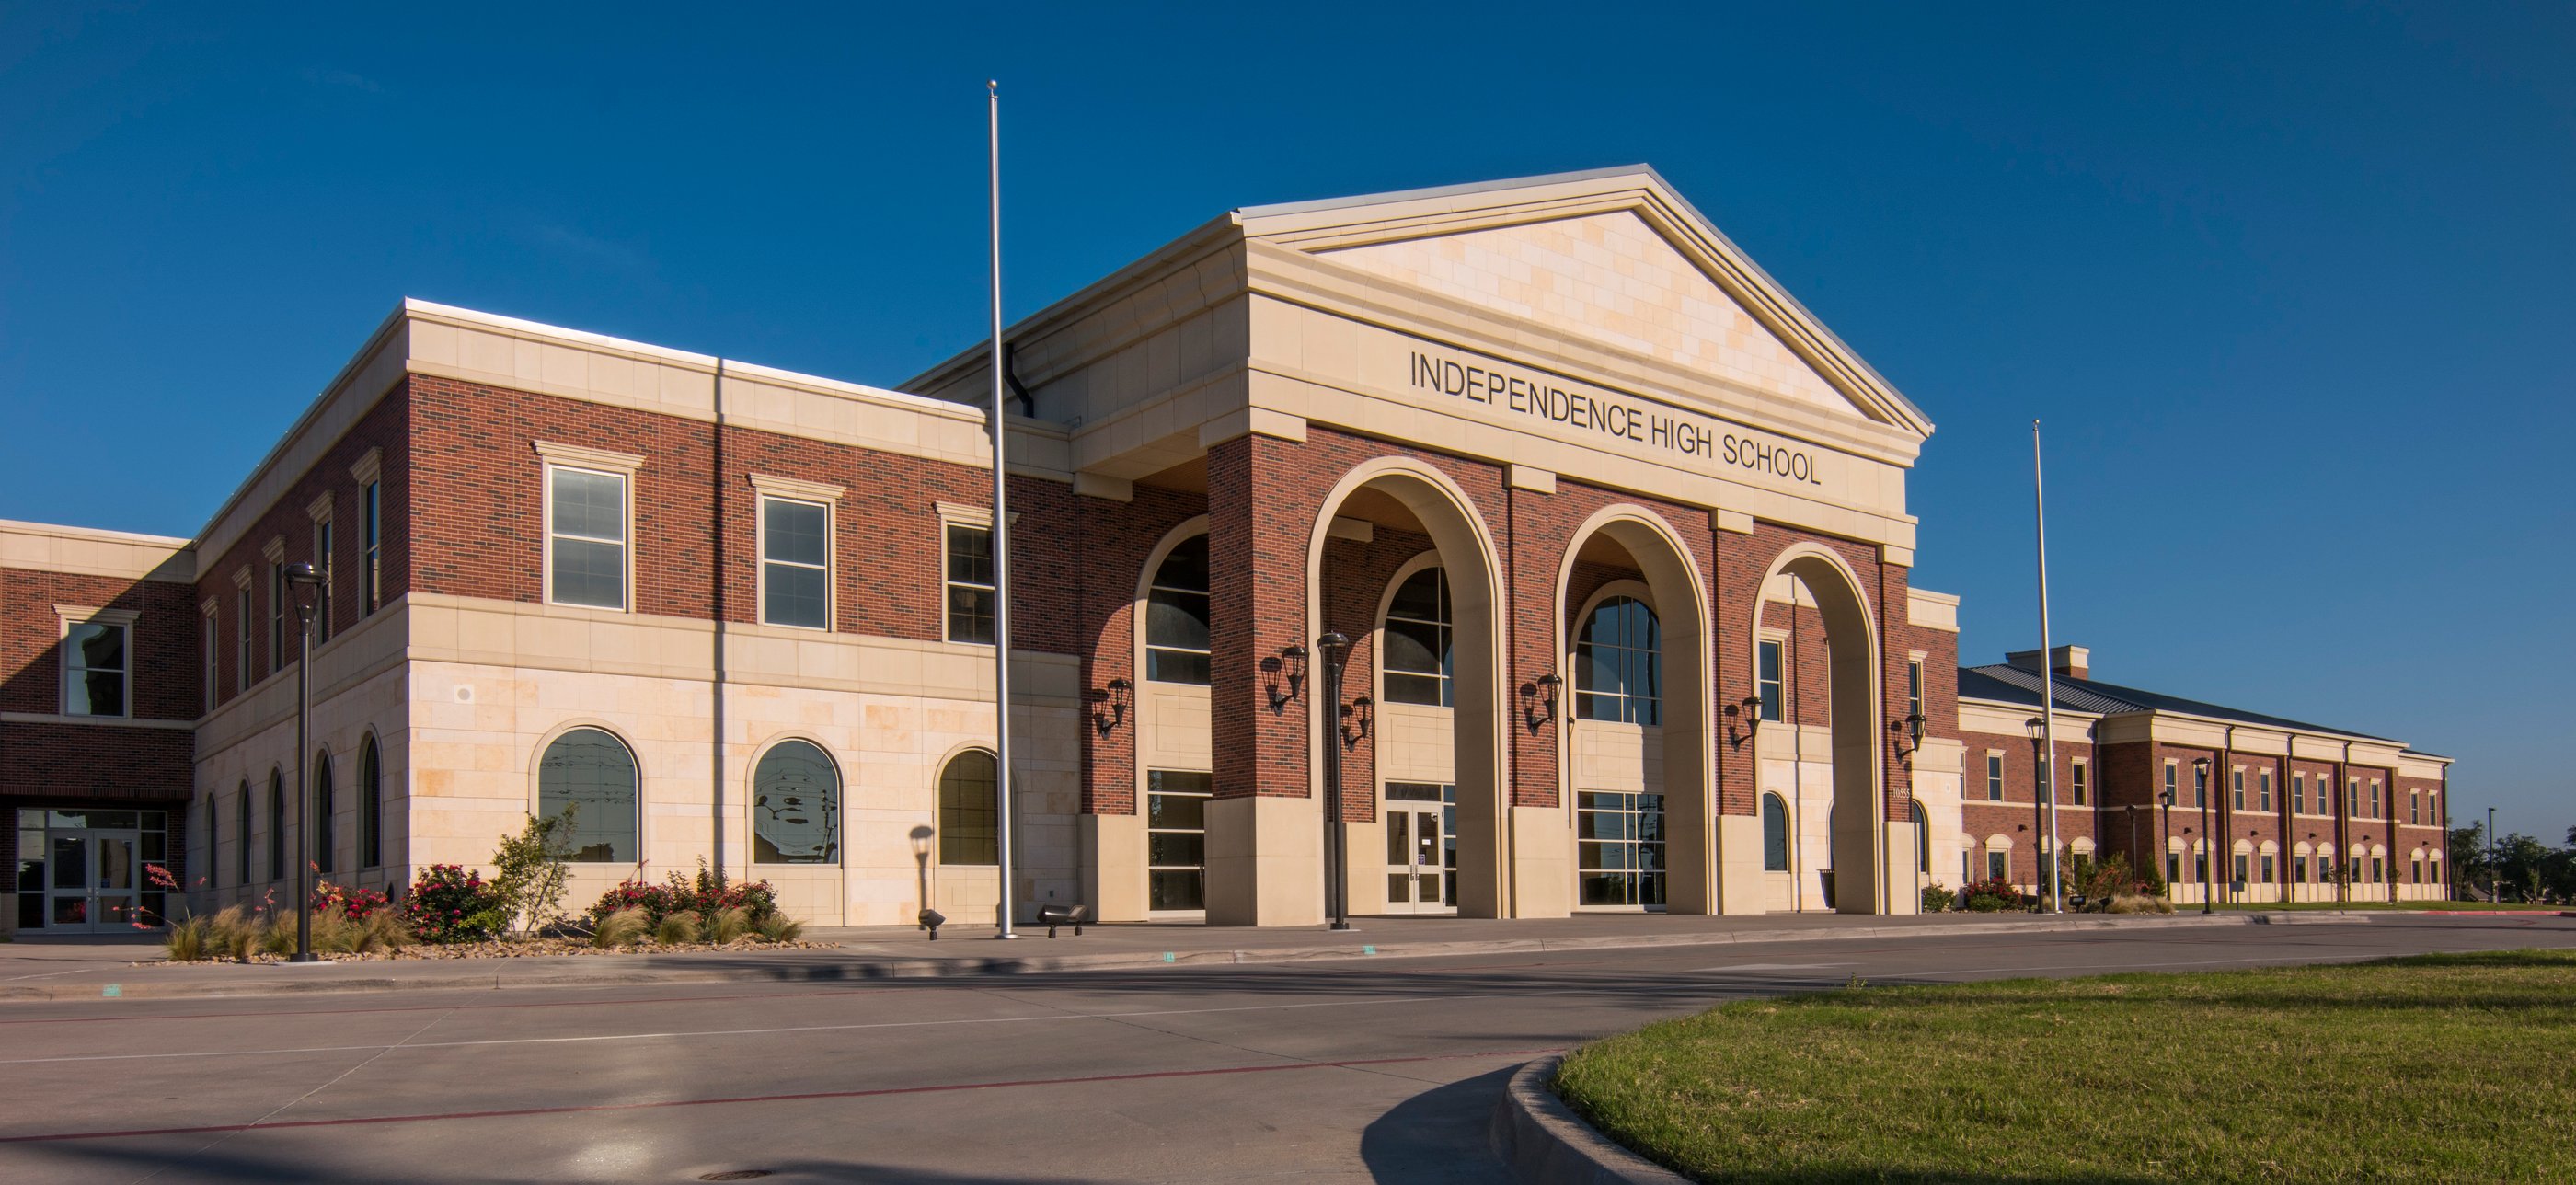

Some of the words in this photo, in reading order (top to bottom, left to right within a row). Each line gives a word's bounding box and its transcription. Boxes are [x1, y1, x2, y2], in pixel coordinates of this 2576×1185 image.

[1411, 351, 1643, 442] INDEPENDENCE
[1651, 415, 1712, 459] HIGH
[1723, 434, 1822, 486] SCHOOL
